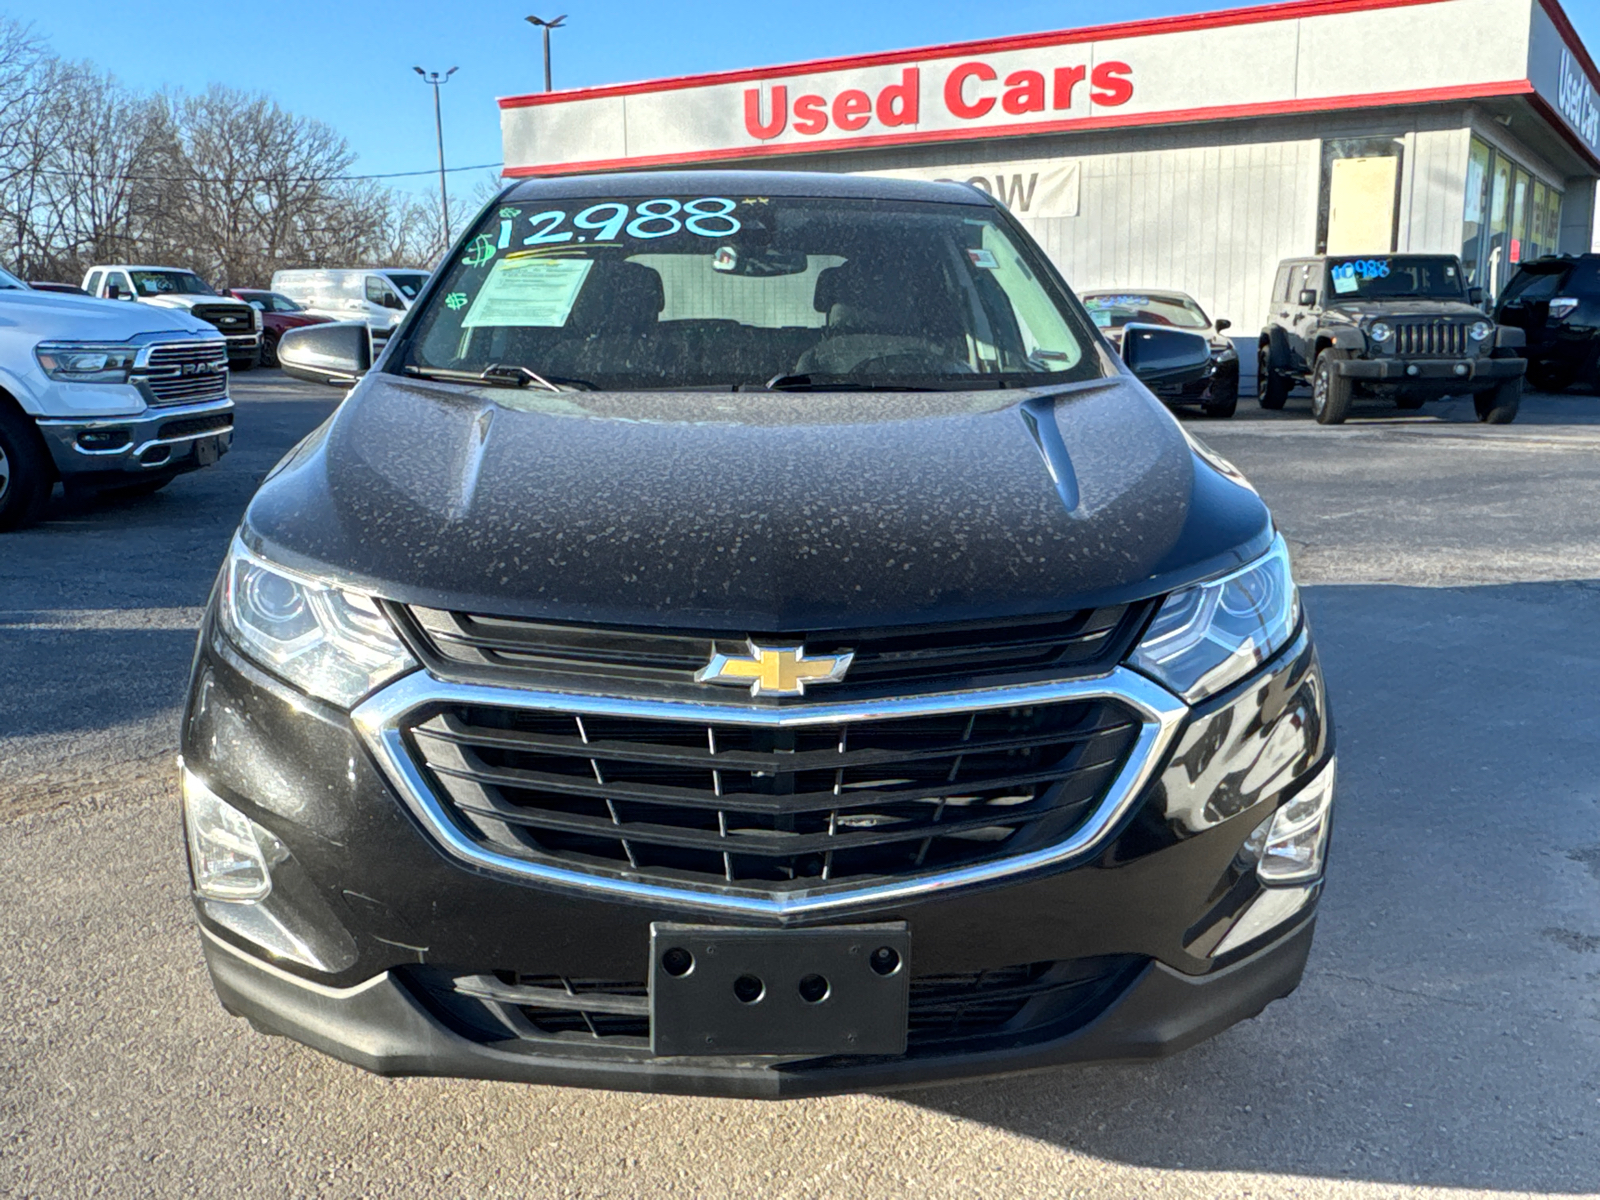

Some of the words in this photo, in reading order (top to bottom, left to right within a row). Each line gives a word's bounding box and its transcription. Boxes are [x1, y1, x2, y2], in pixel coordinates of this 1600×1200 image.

[743, 67, 920, 140] Used
[943, 61, 1134, 120] Cars
[1558, 47, 1585, 128] Used
[1580, 83, 1599, 149] Cars
